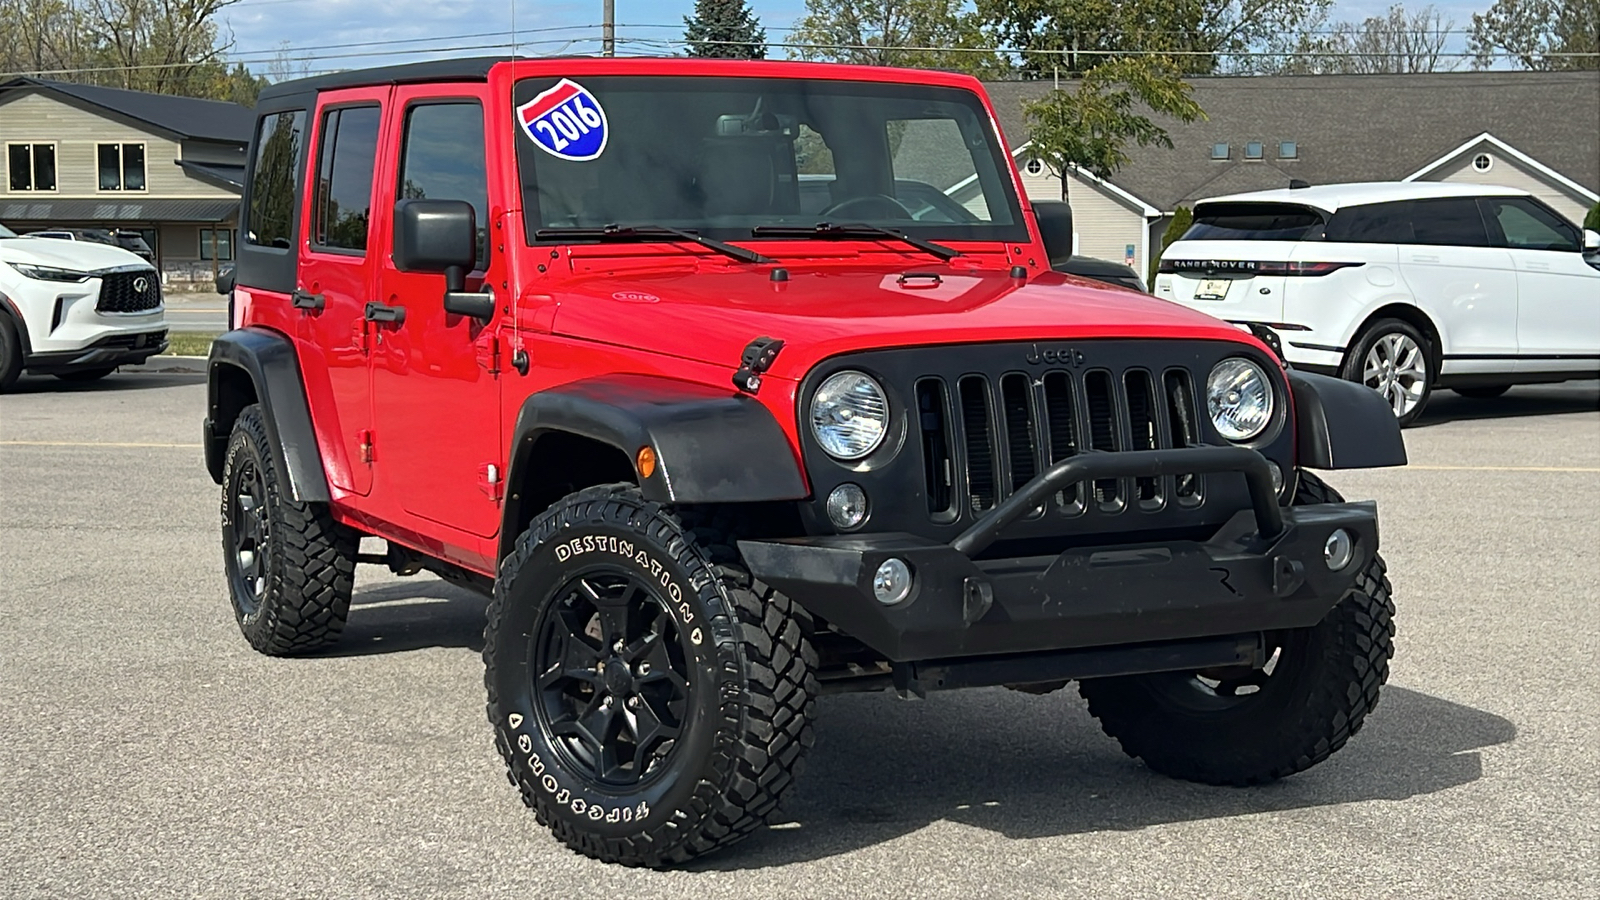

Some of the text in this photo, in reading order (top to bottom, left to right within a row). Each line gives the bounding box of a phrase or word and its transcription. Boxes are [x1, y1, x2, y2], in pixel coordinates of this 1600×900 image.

[536, 96, 601, 152] 2016
[1174, 261, 1255, 269] RANGE ROVER
[1026, 343, 1086, 368] Jeep
[555, 535, 694, 624] DESTINATION
